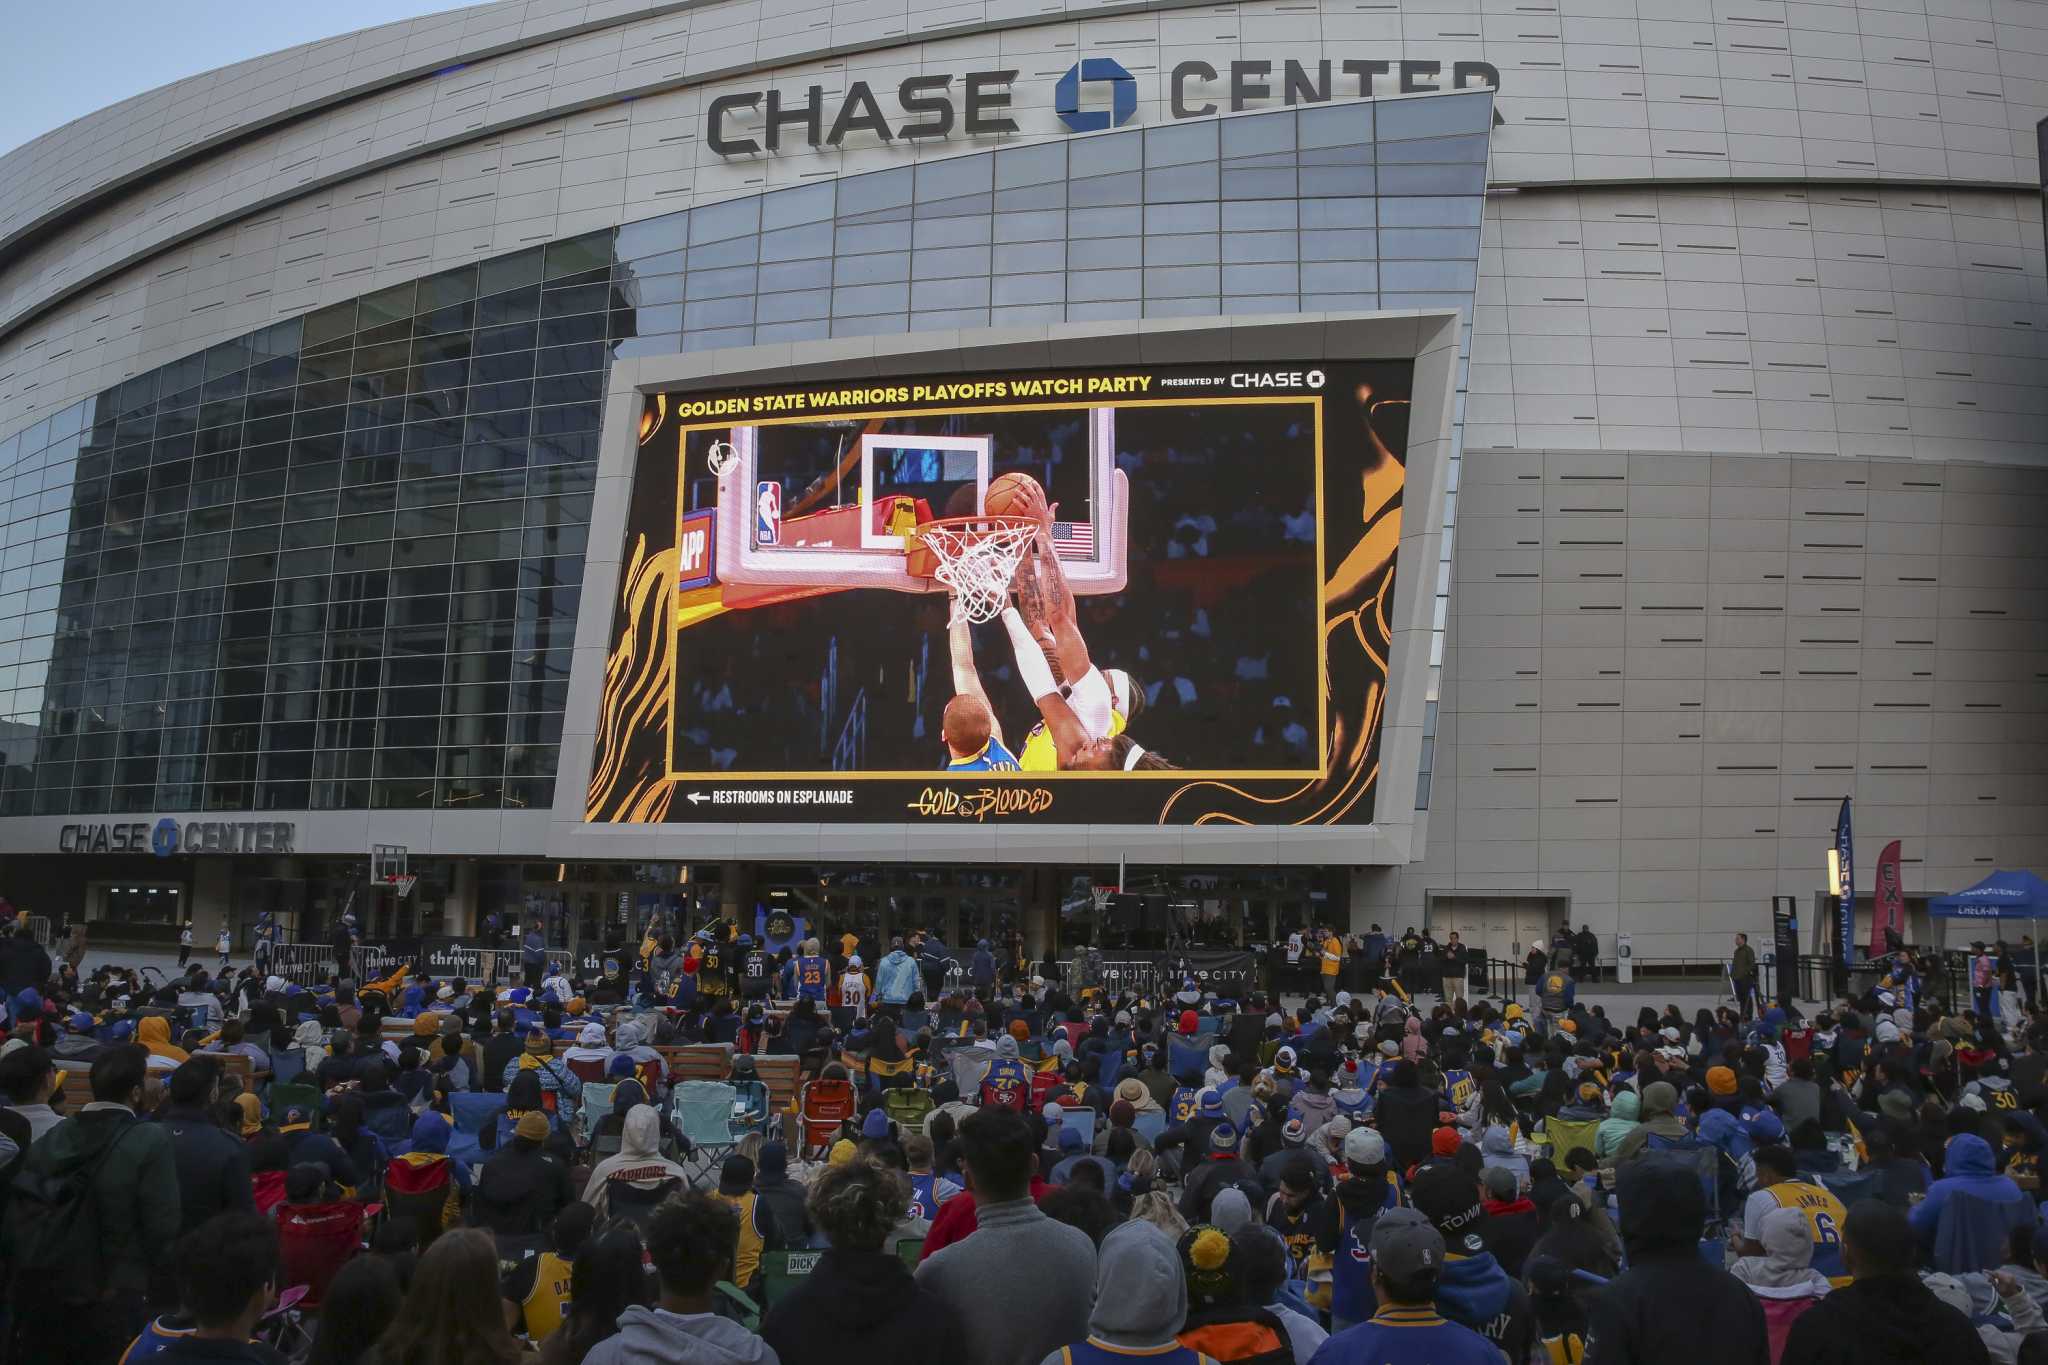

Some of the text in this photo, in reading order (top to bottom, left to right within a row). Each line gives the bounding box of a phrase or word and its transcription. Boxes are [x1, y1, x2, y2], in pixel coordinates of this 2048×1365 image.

[706, 69, 1019, 155] CHASE
[678, 372, 1303, 418] GOLDEN STATE WARRIORS PLAYOFFS WATCH PARTY PRESENTED BY CHASE
[713, 790, 853, 805] RESTROOMS ON ESPLANADE
[59, 821, 296, 853] CHASE CENTER
[1882, 863, 1899, 928] EXI
[365, 954, 396, 969] thrive
[429, 953, 477, 966] thrive
[803, 971, 821, 985] 23
[1212, 969, 1249, 981] CITY
[844, 990, 861, 1005] 30
[1990, 1091, 2017, 1109] 30
[1795, 1193, 1829, 1209] JAMES
[1440, 1203, 1481, 1231] TOWN
[1815, 1211, 1841, 1243] 6
